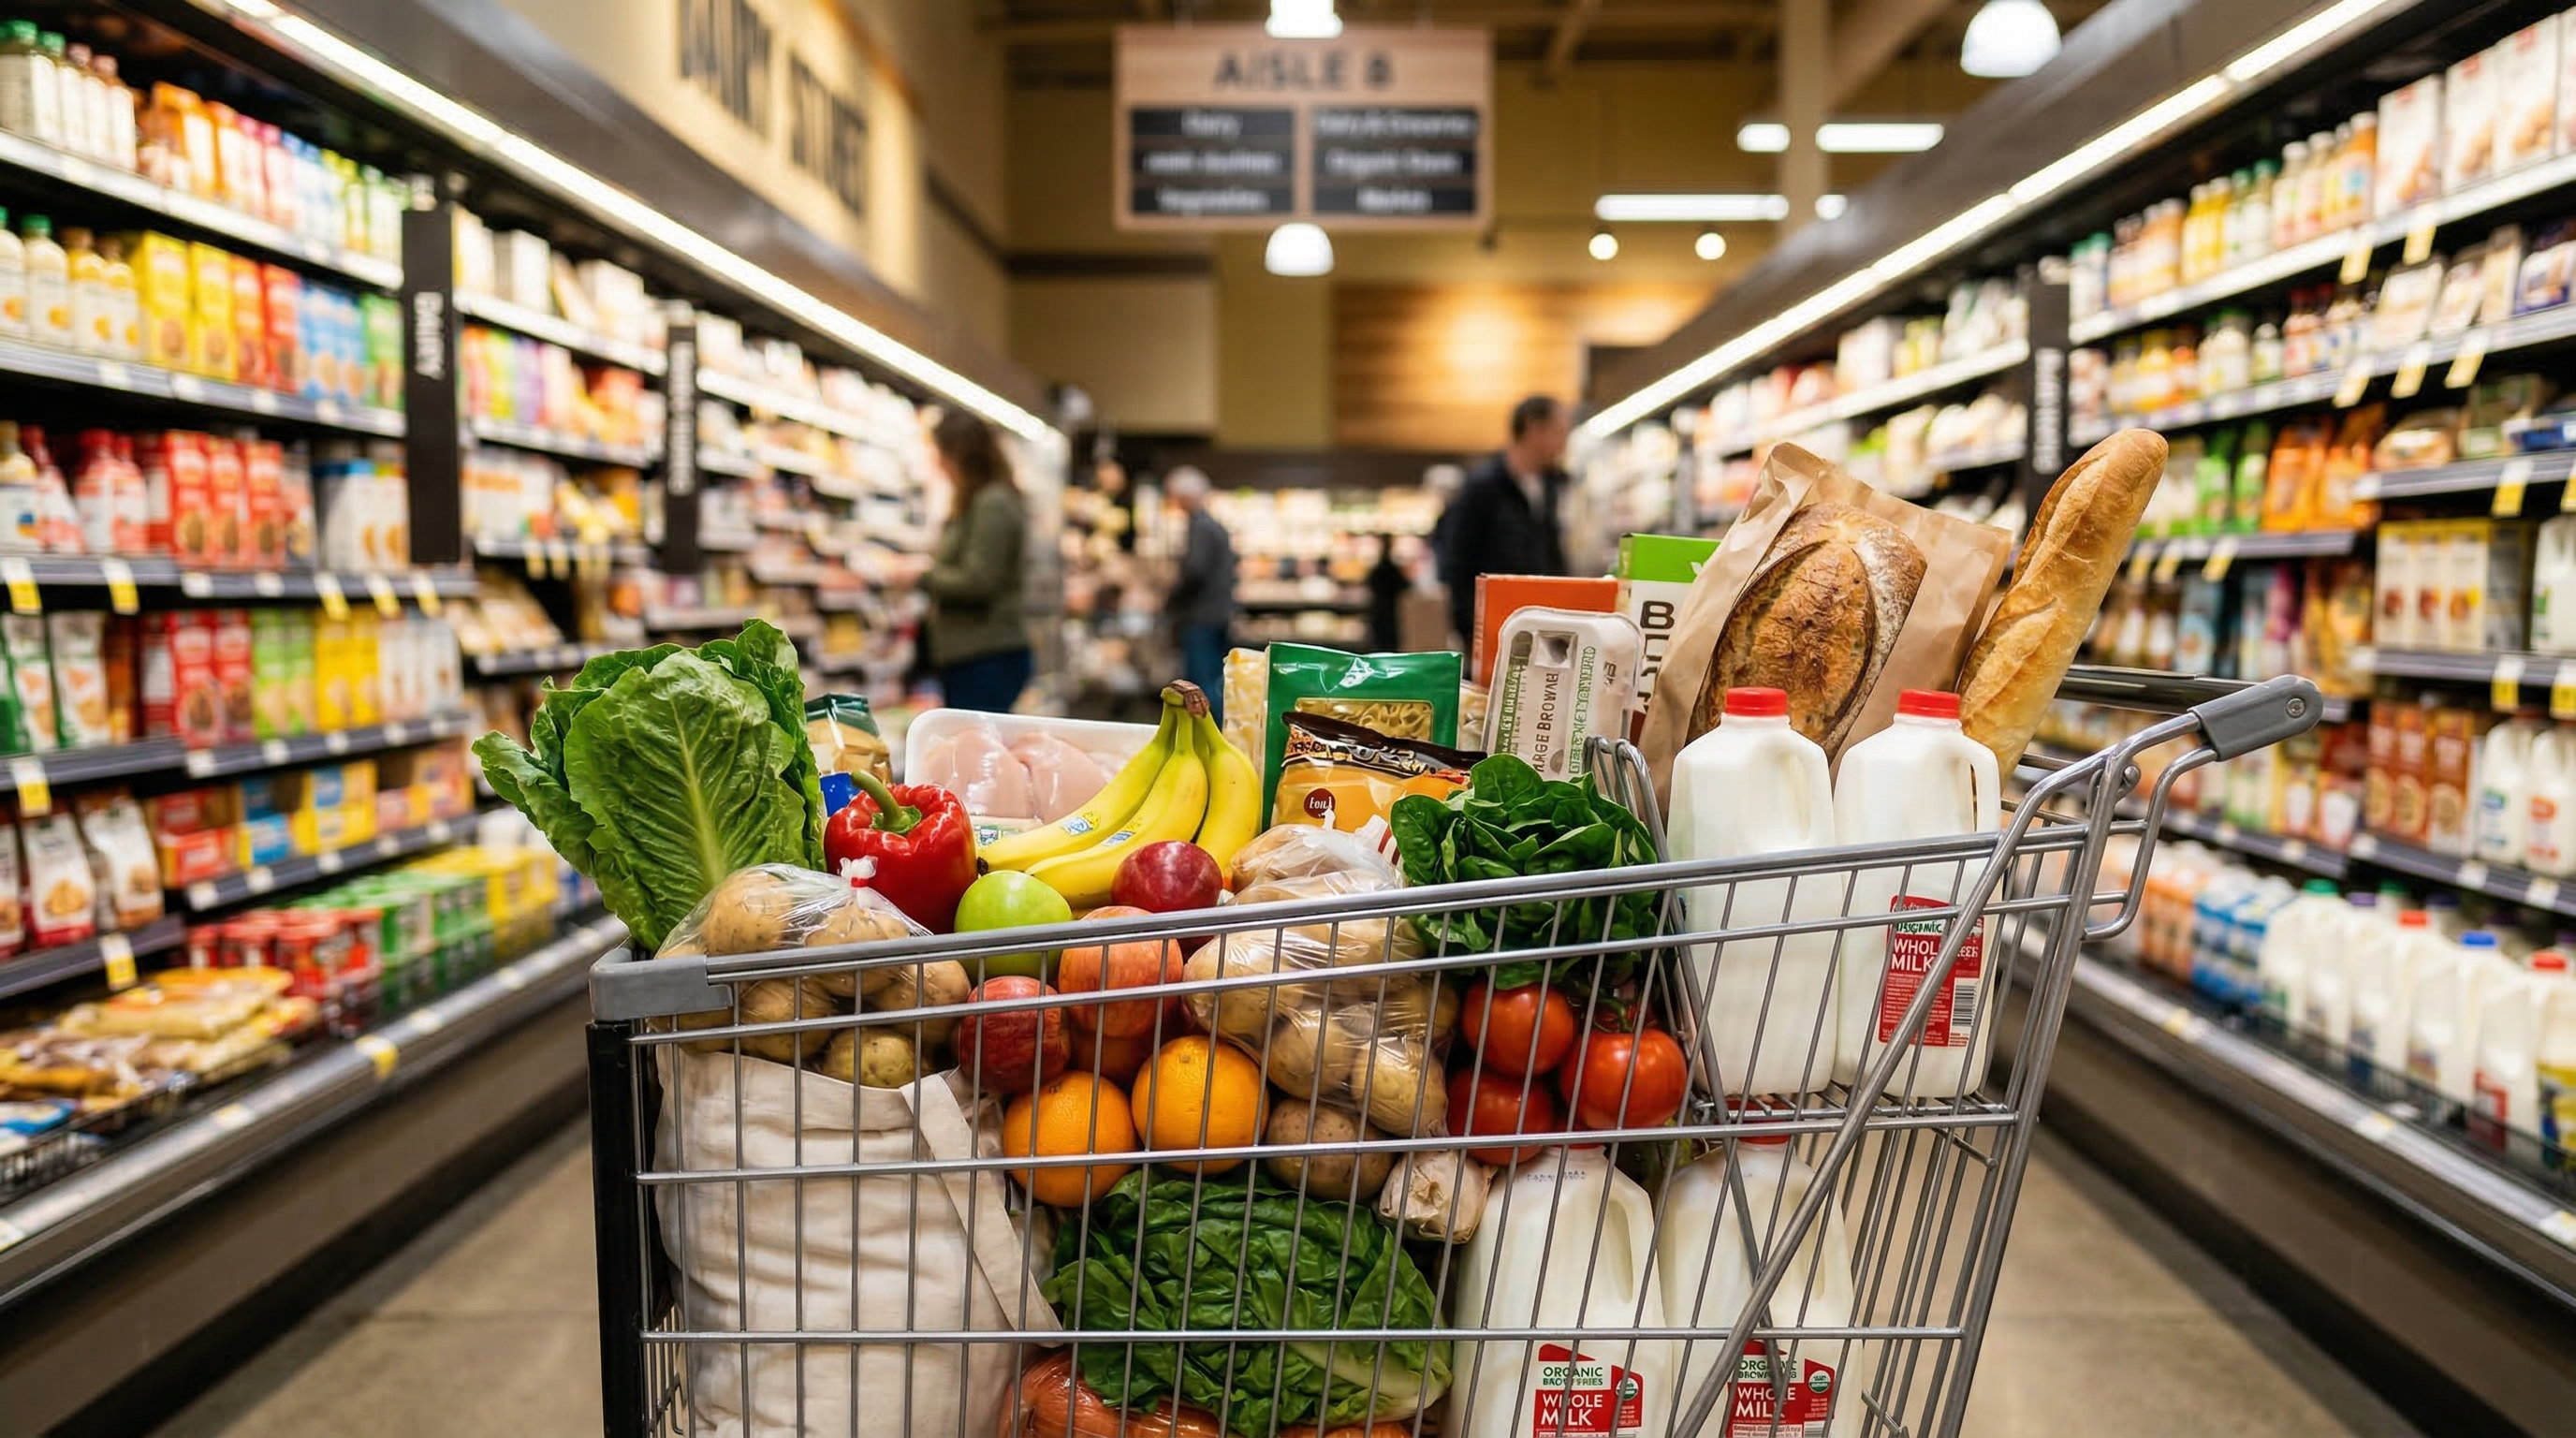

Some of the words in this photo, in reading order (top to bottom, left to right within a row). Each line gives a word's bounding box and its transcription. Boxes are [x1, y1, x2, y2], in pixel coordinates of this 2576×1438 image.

[1894, 938, 1940, 955] WHOL
[1737, 1387, 1795, 1401] WHOE
[1541, 1408, 1592, 1426] MLK
